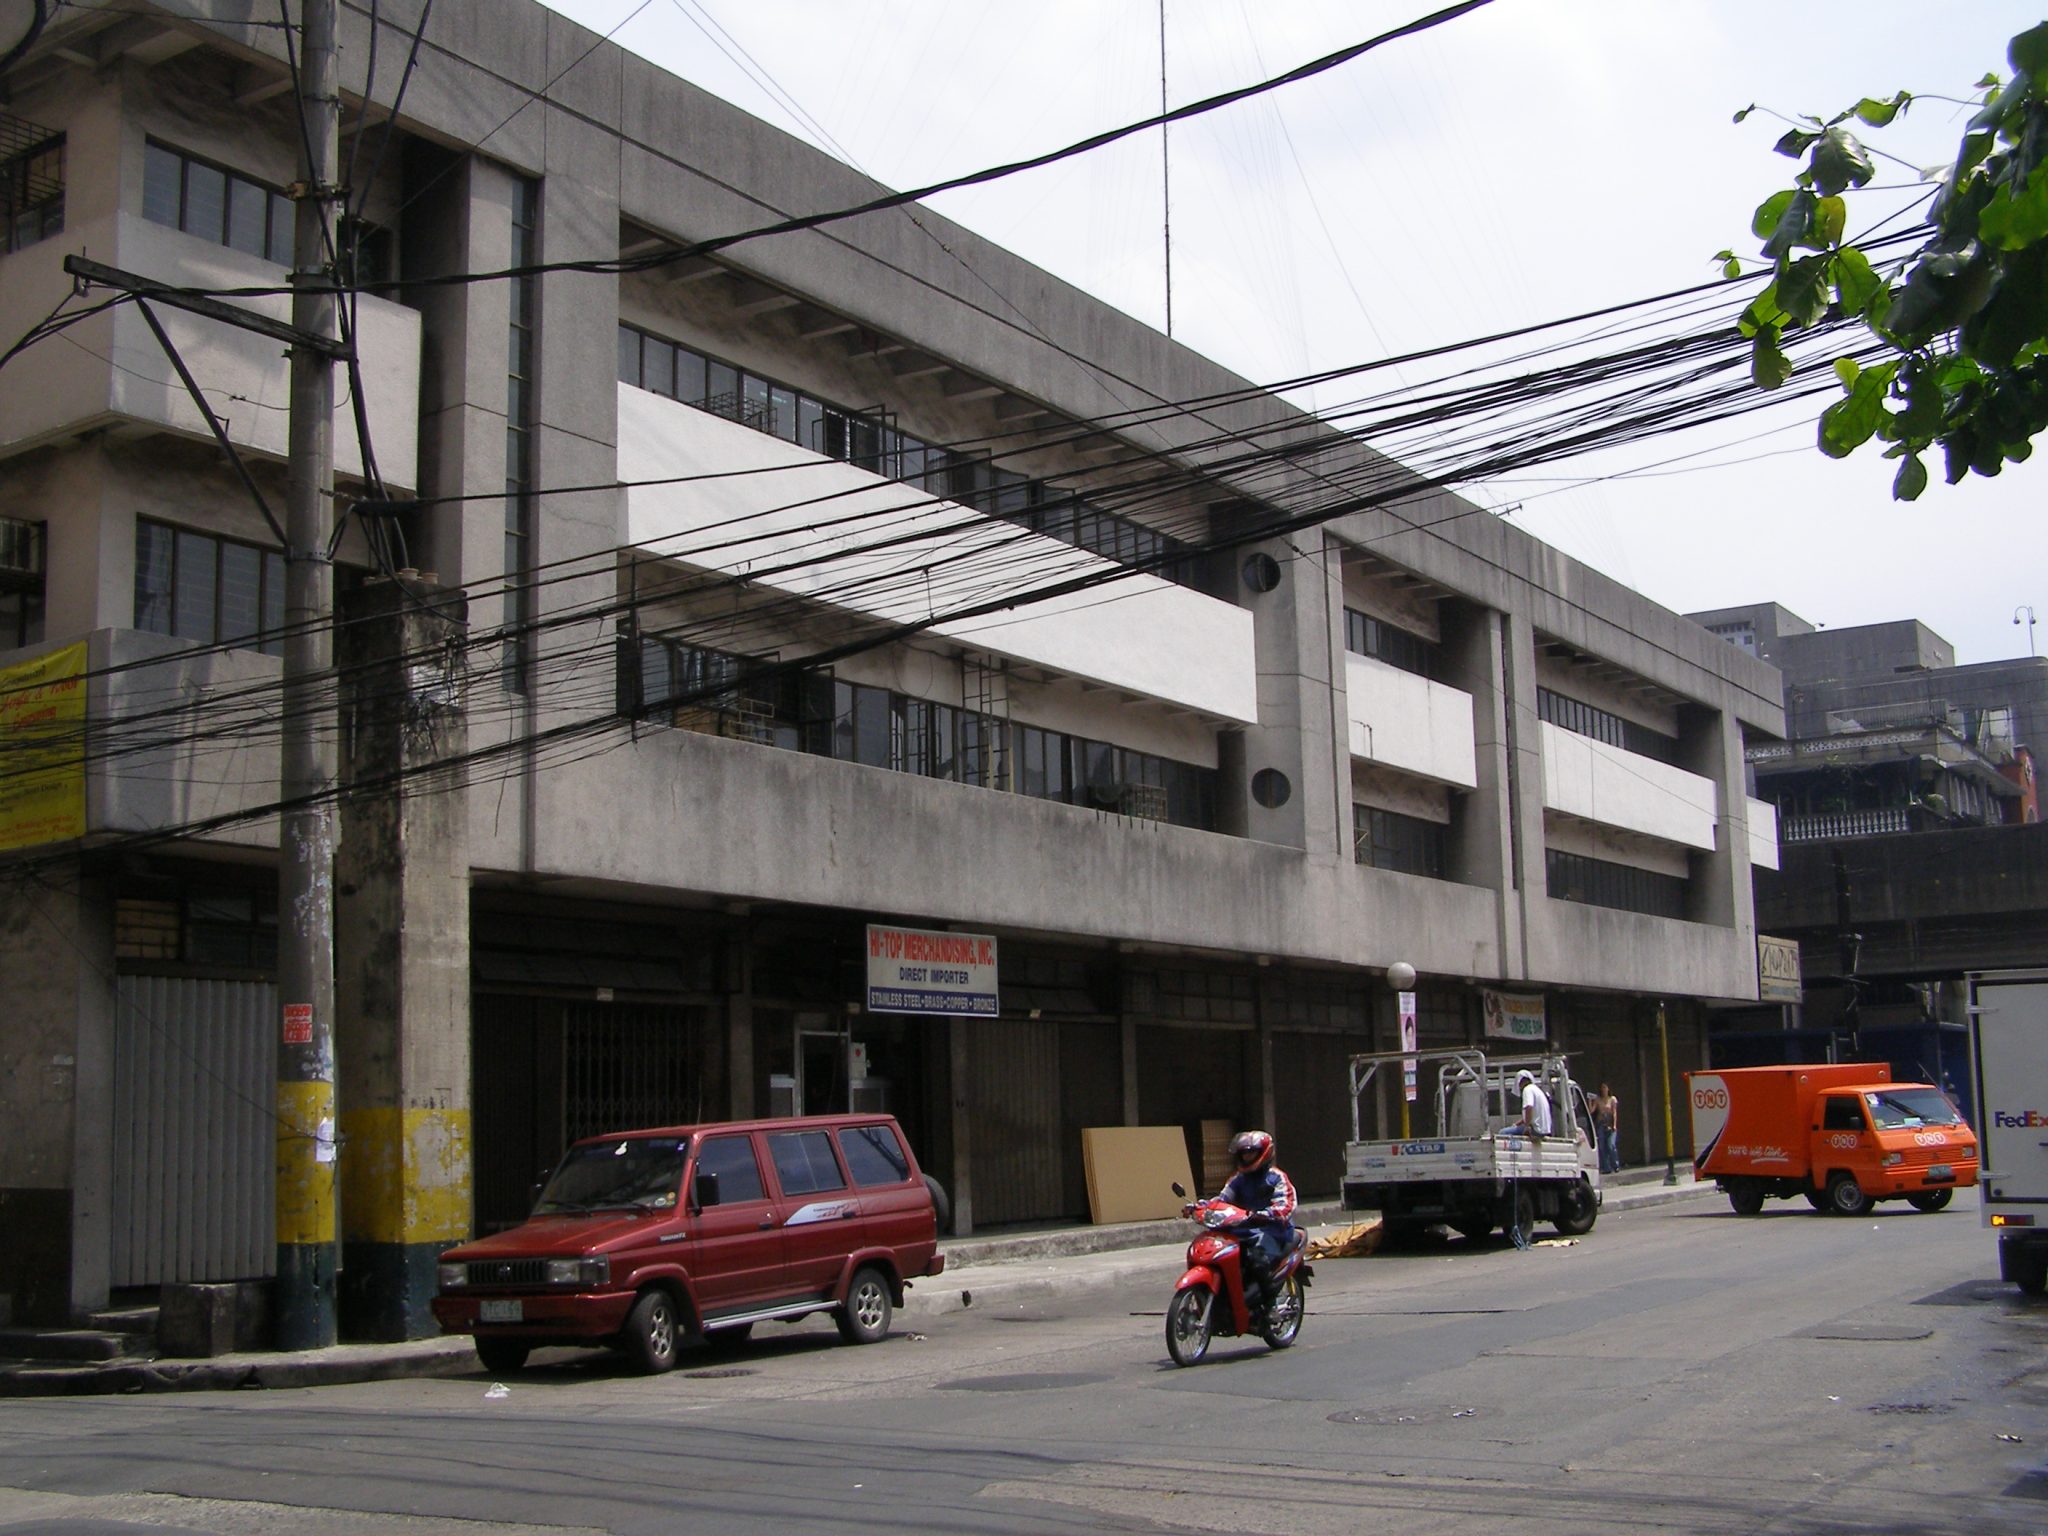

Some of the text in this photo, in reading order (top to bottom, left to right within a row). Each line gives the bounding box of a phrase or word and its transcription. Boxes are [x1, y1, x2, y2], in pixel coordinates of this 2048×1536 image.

[899, 967, 969, 985] DIRECT IMPORTER
[871, 991, 903, 1007] STAINLESS
[973, 998, 995, 1011] BRONZE
[1693, 1088, 1728, 1109] TNT
[1831, 1134, 1857, 1149] TNT
[1914, 1131, 1946, 1146] TNT
[1727, 1145, 1748, 1156] sure
